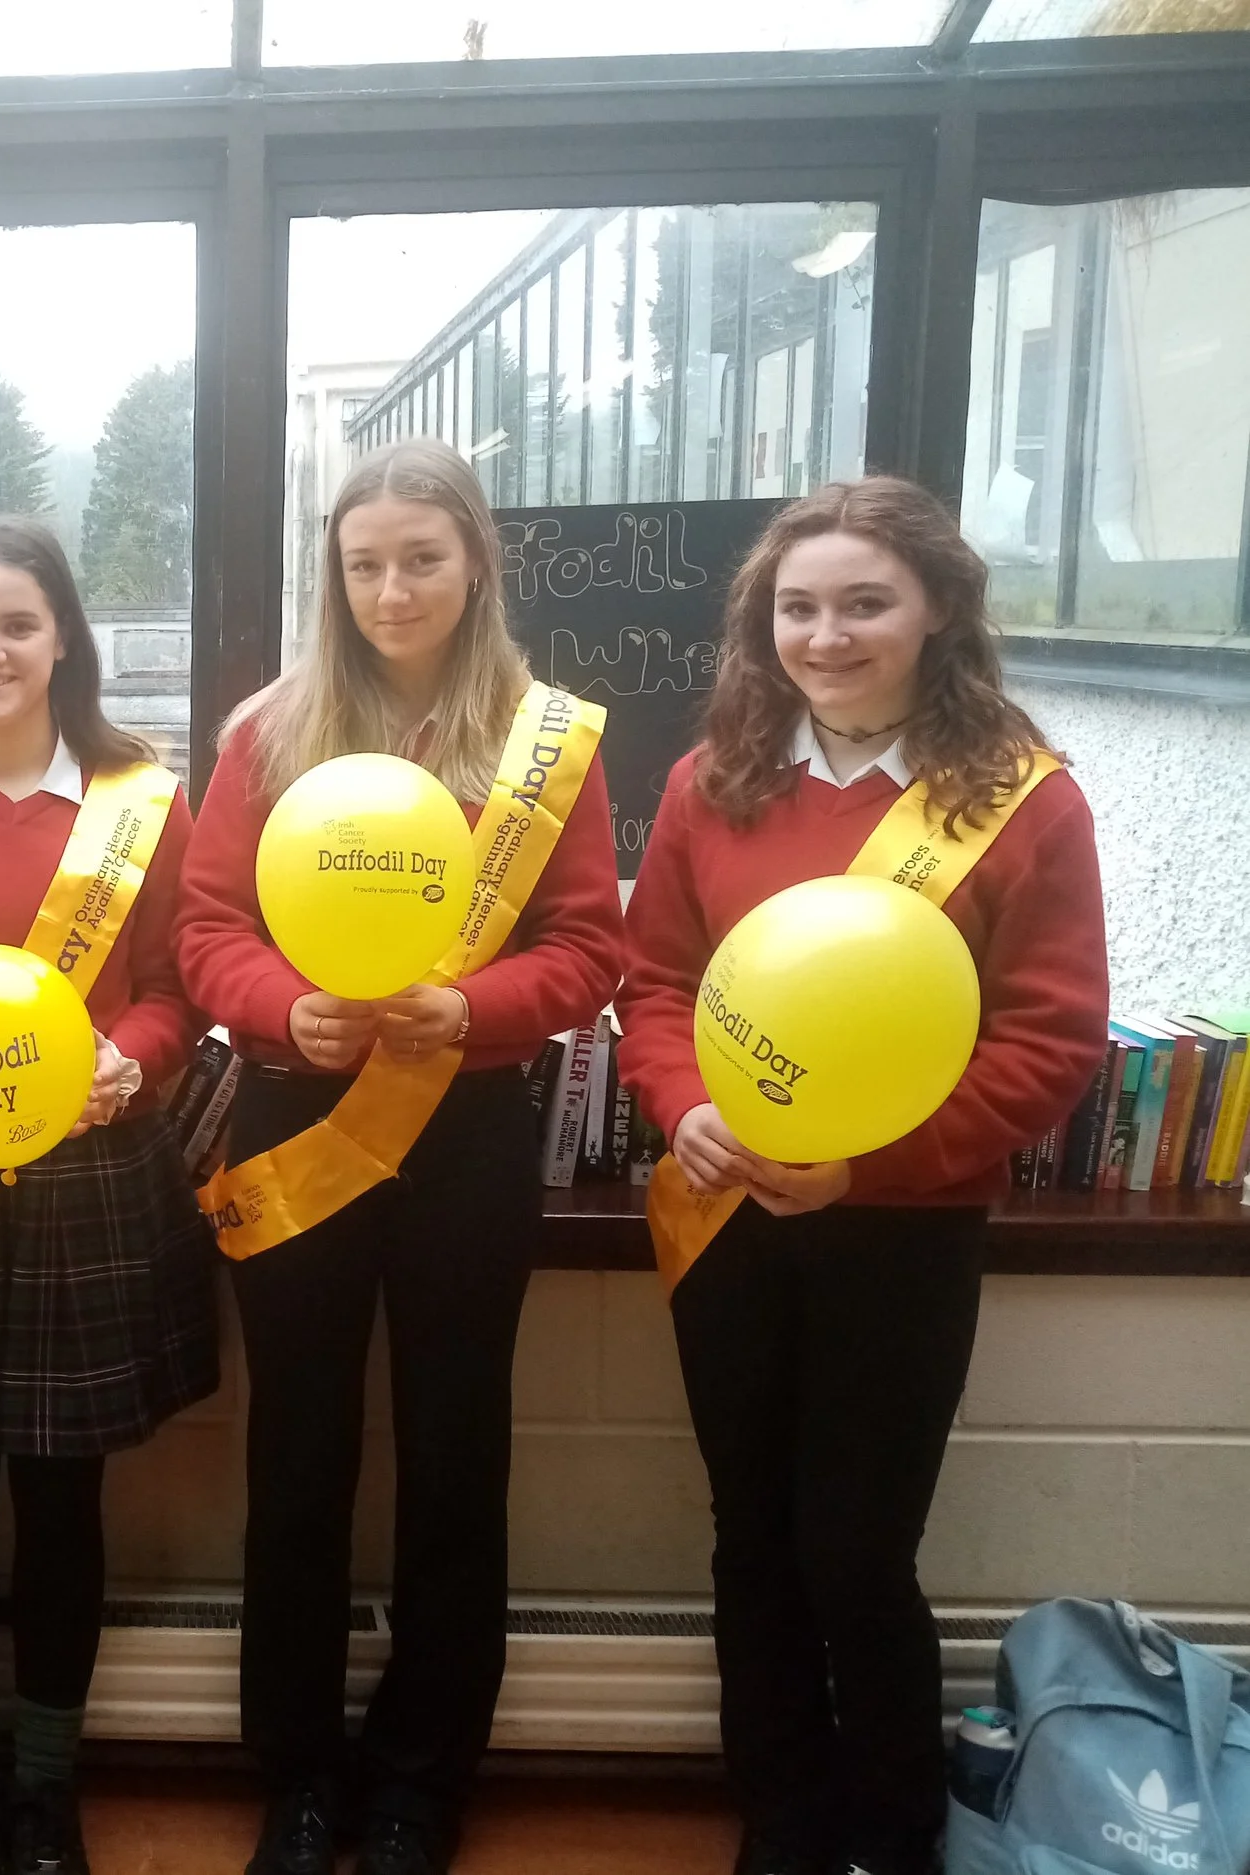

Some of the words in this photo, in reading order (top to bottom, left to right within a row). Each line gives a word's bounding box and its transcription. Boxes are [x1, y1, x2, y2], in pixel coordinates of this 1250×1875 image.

[511, 742, 563, 812] Day
[74, 855, 114, 922] Ordinary
[104, 807, 132, 854] Heroes
[318, 849, 404, 872] Daffodil
[411, 852, 447, 880] Day
[338, 837, 366, 846] Society
[479, 811, 520, 877] Against
[487, 817, 531, 891] Ordinary
[86, 868, 122, 930] Against
[114, 817, 143, 868] Cancer
[353, 886, 377, 894] Proudly
[379, 887, 410, 895] supported
[466, 890, 498, 948] Heroes
[569, 1025, 597, 1082] KILLER
[751, 1034, 808, 1088] Day
[218, 1088, 228, 1100] US
[6, 1118, 47, 1144] Boots
[566, 1120, 578, 1154] ROBERT
[1102, 1822, 1199, 1870] adidas
